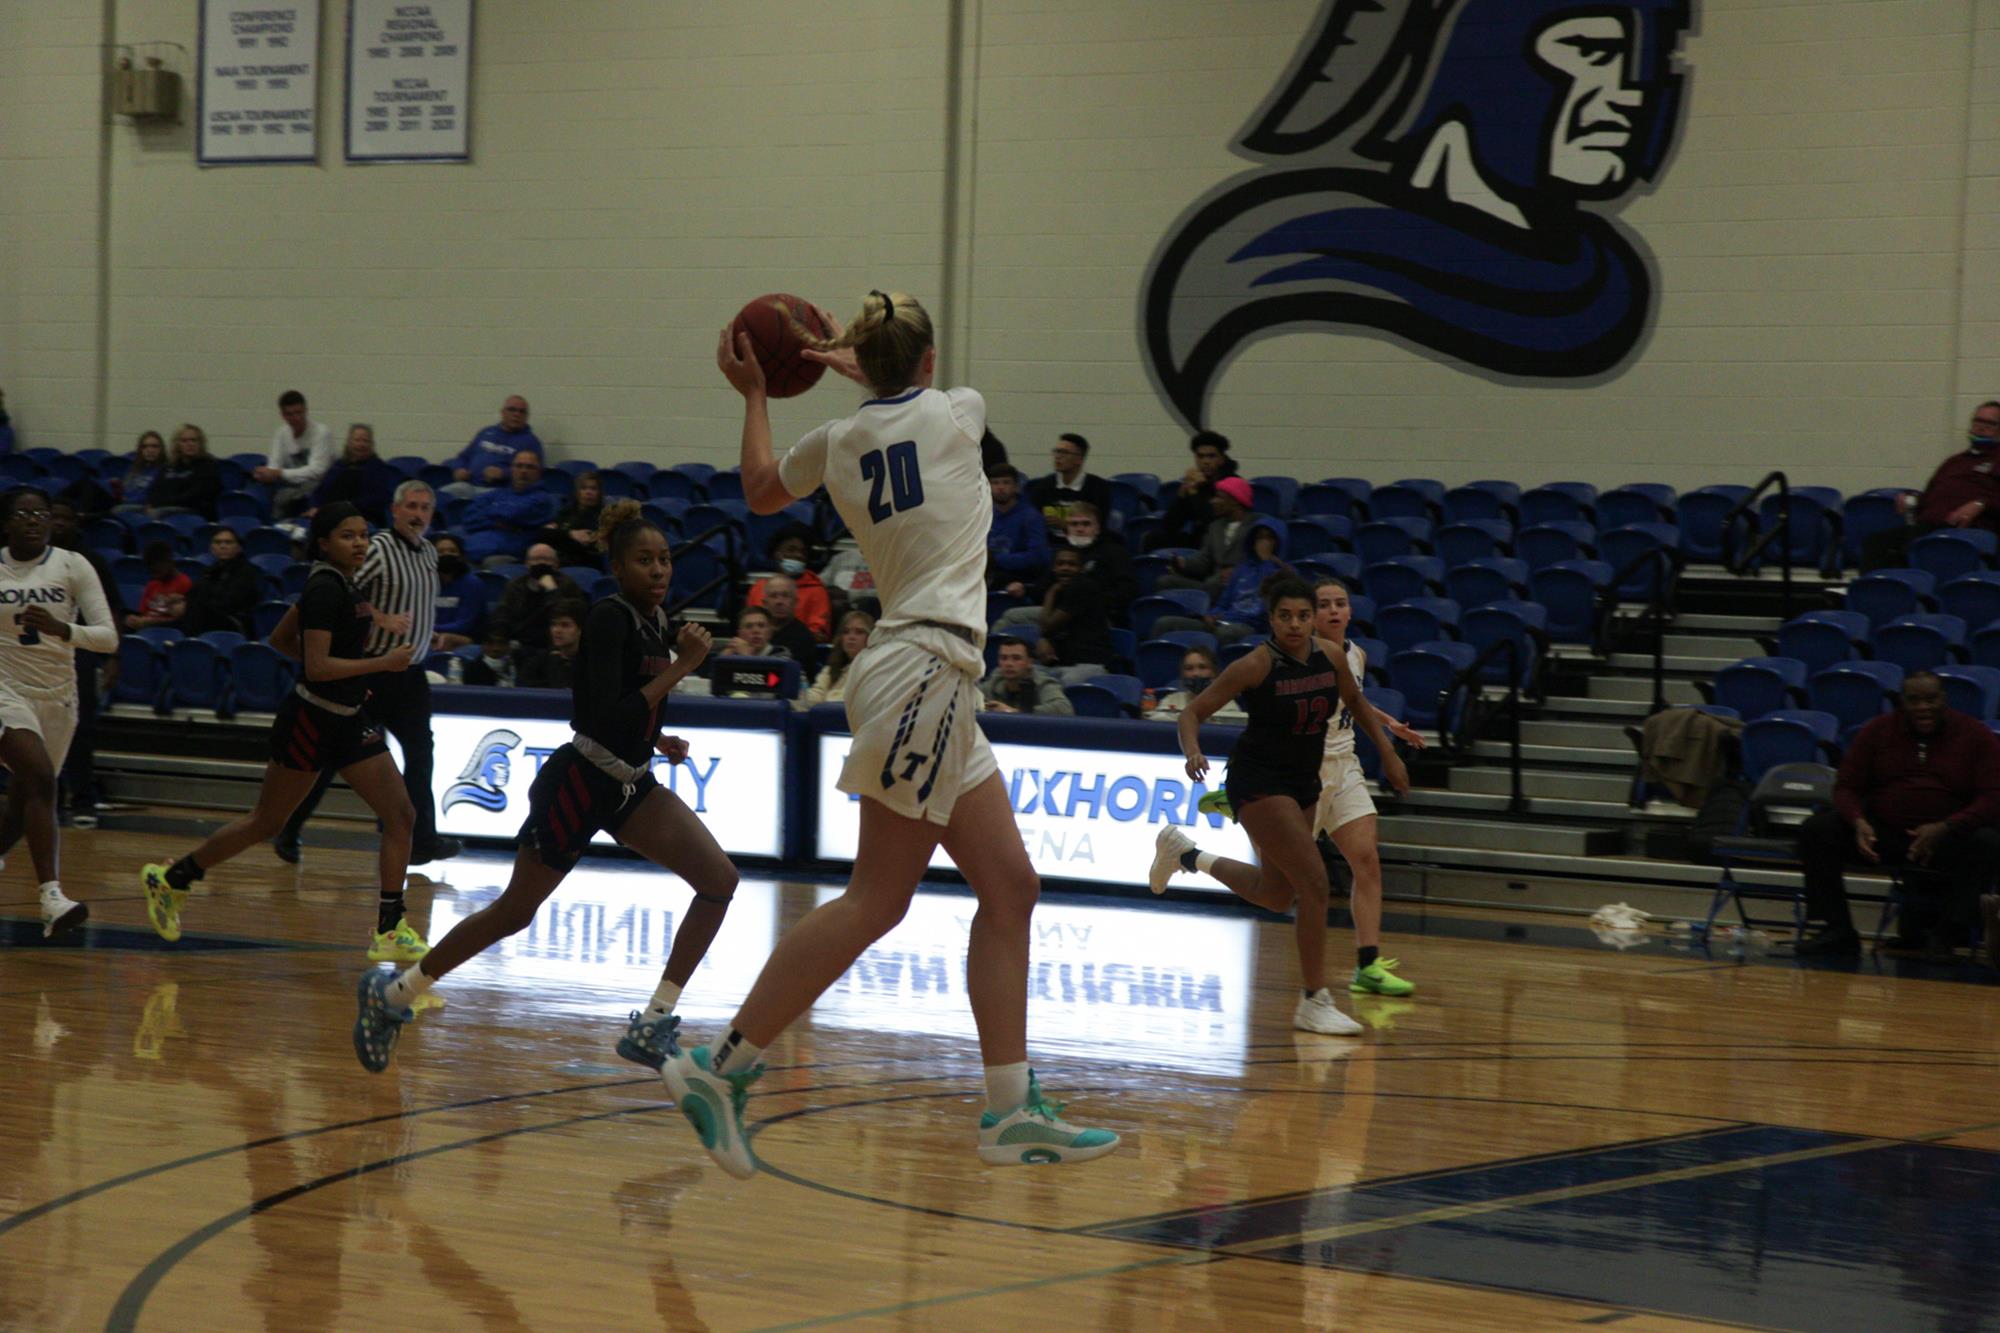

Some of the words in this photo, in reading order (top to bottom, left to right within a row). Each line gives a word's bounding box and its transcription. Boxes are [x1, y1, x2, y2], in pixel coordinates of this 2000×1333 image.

[230, 9, 297, 23] CONFERENCE
[232, 22, 295, 35] CHAMPIONS
[385, 18, 439, 31] REGIONAL
[380, 29, 445, 43] CHAMPIONS
[242, 63, 311, 77] TOURNAMENT
[372, 89, 448, 103] TOURNAMENT
[243, 107, 315, 121] TOURNAMENT
[860, 440, 925, 526] 20
[1291, 695, 1330, 736] 12
[899, 751, 928, 782] T
